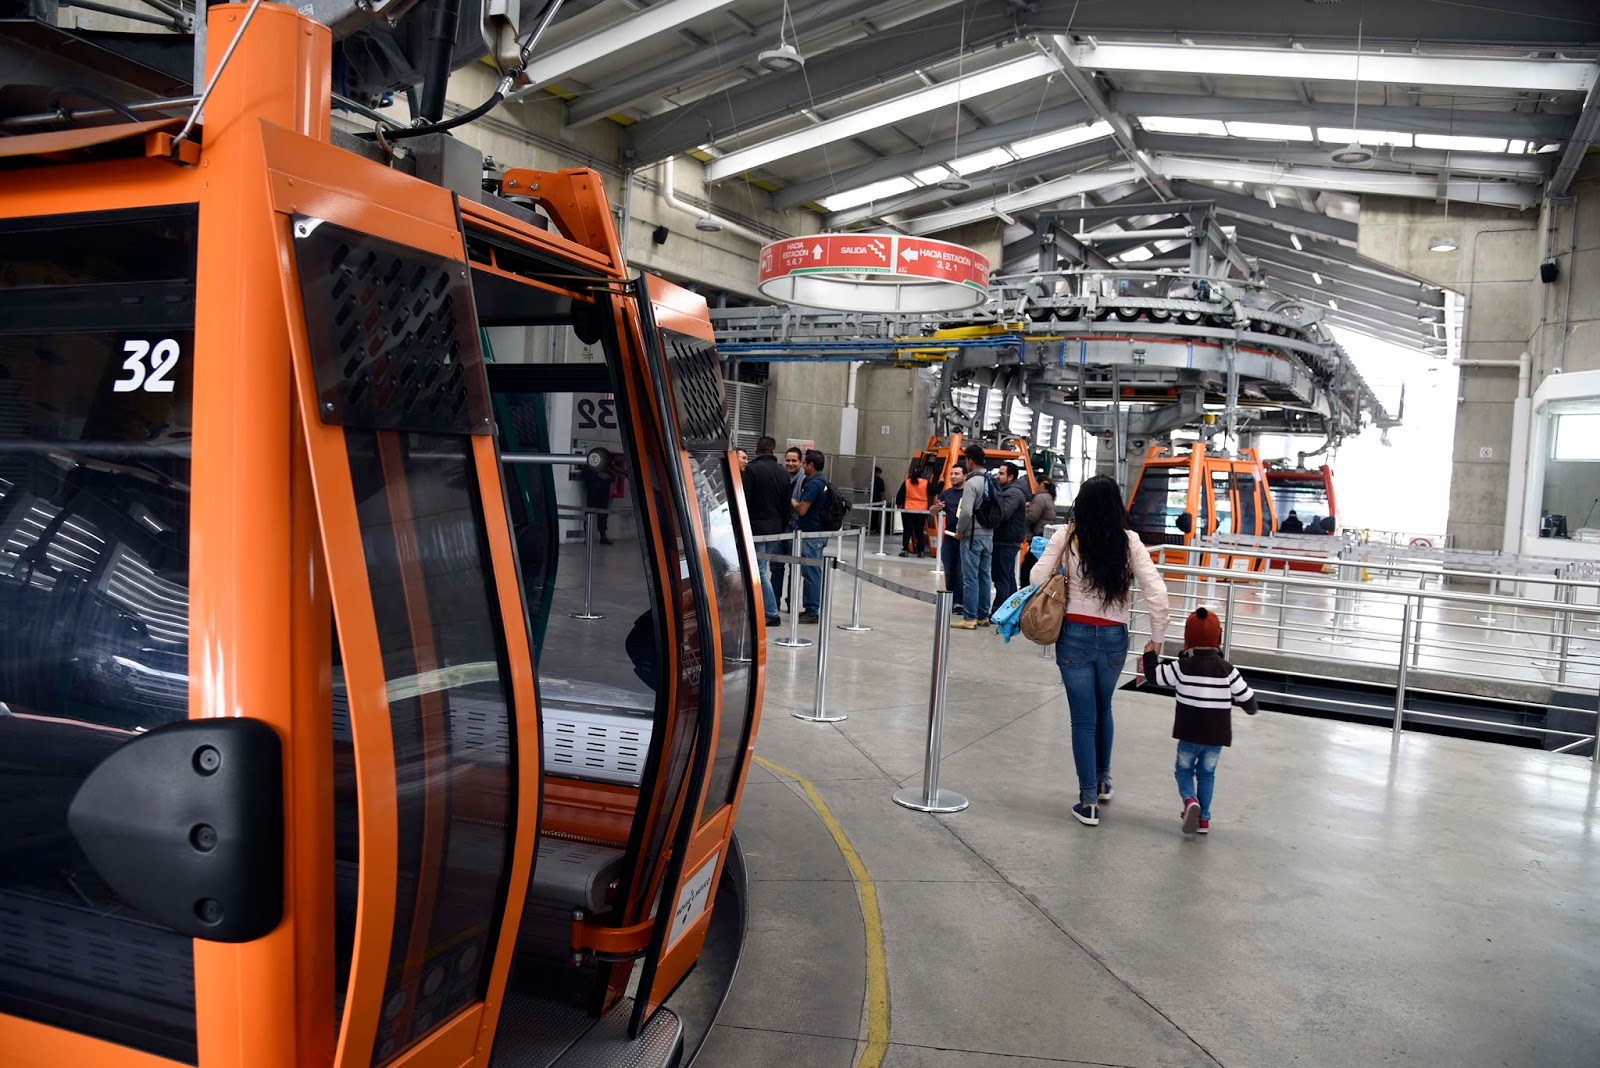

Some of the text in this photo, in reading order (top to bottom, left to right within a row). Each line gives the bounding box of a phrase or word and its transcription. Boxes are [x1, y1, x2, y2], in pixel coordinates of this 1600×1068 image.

[787, 242, 804, 250] HACIA
[840, 246, 867, 254] SALIDA
[919, 248, 972, 266] HACIA ESTACIÓN
[113, 338, 180, 392] 32
